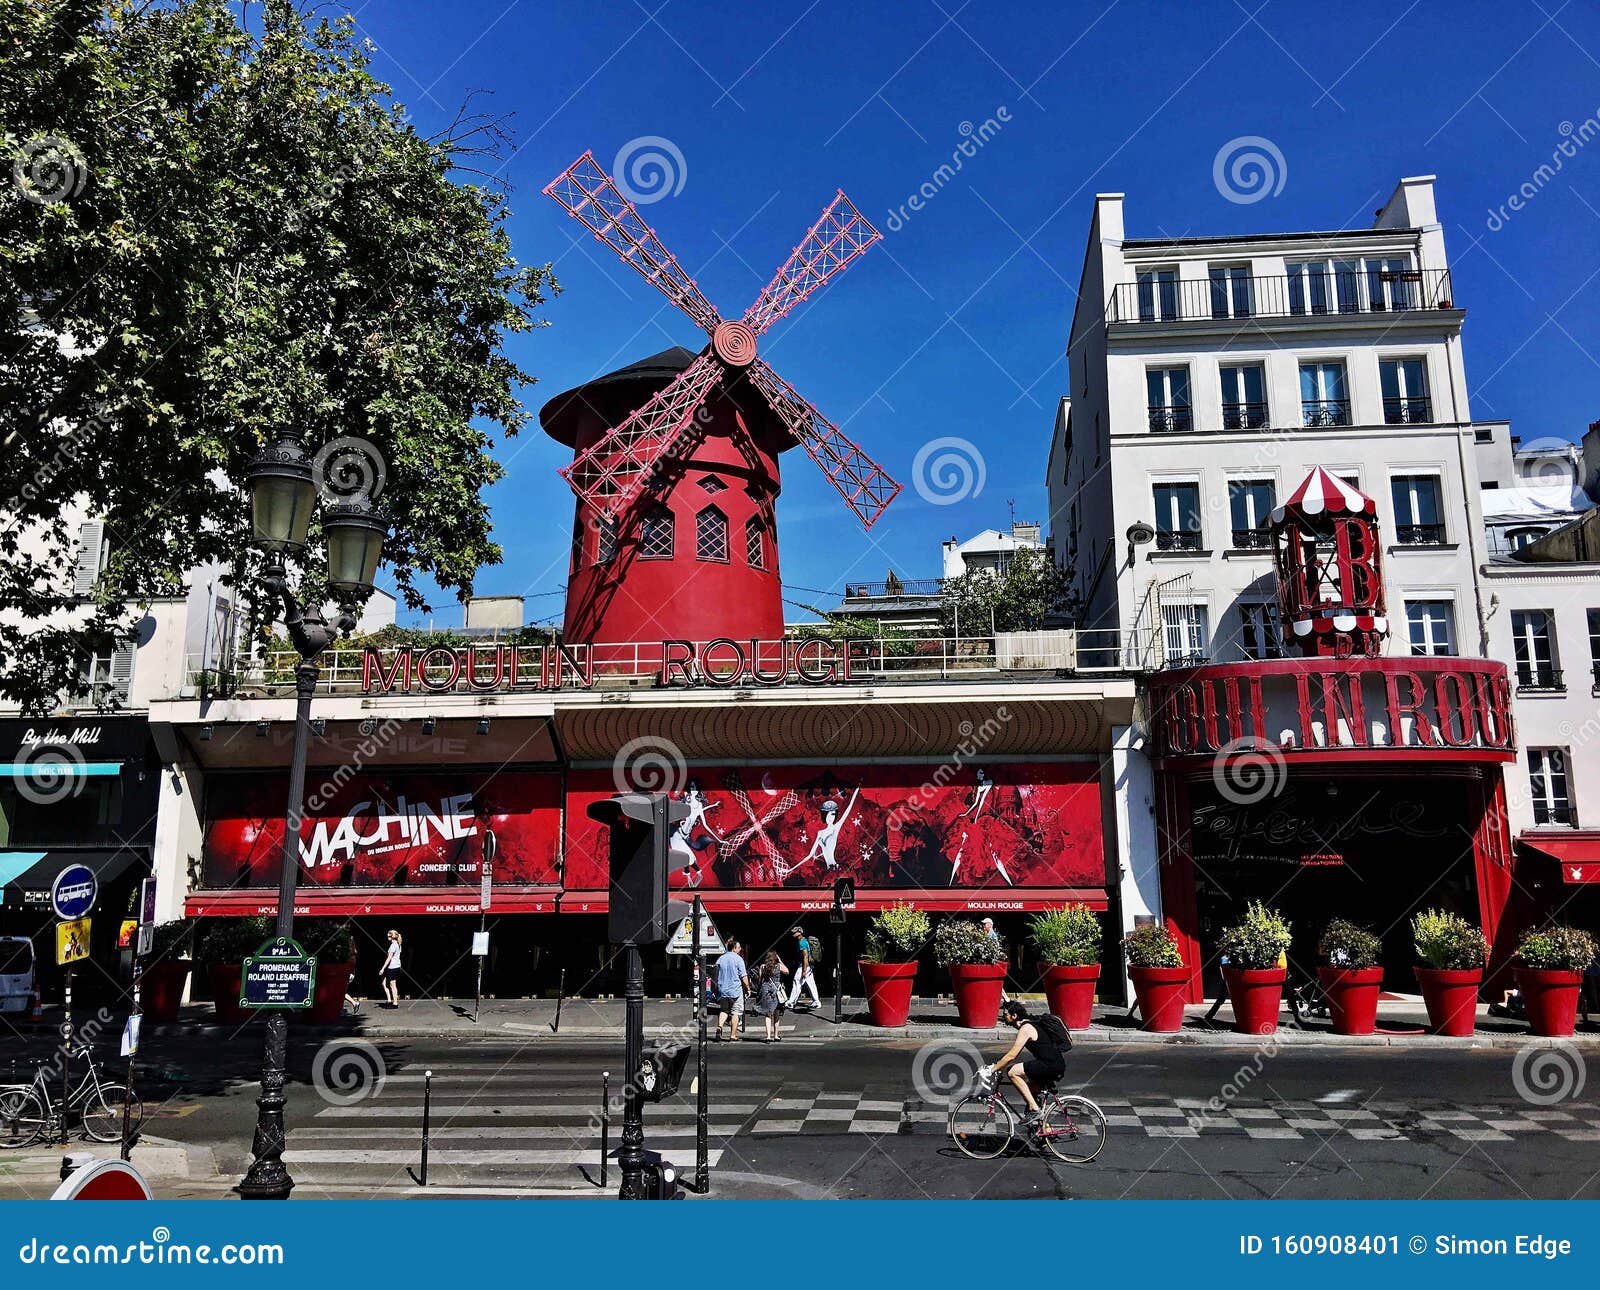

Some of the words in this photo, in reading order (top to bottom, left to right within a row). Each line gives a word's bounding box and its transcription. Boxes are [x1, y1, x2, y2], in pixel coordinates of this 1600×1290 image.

[361, 640, 595, 693] MOULIN
[661, 638, 876, 688] ROUGE
[1153, 671, 1367, 751] OULIN
[21, 728, 42, 750] By
[43, 728, 67, 745] the
[67, 727, 101, 745] Mill
[299, 793, 477, 868] MACHINE
[419, 863, 457, 873] CONCERTS
[458, 863, 477, 872] CLUB
[426, 904, 454, 912] MOULIN
[454, 904, 480, 912] ROUGE
[259, 963, 300, 972] PROMENADE
[247, 973, 275, 981] ROLAND
[275, 973, 309, 981] LESAFFRE
